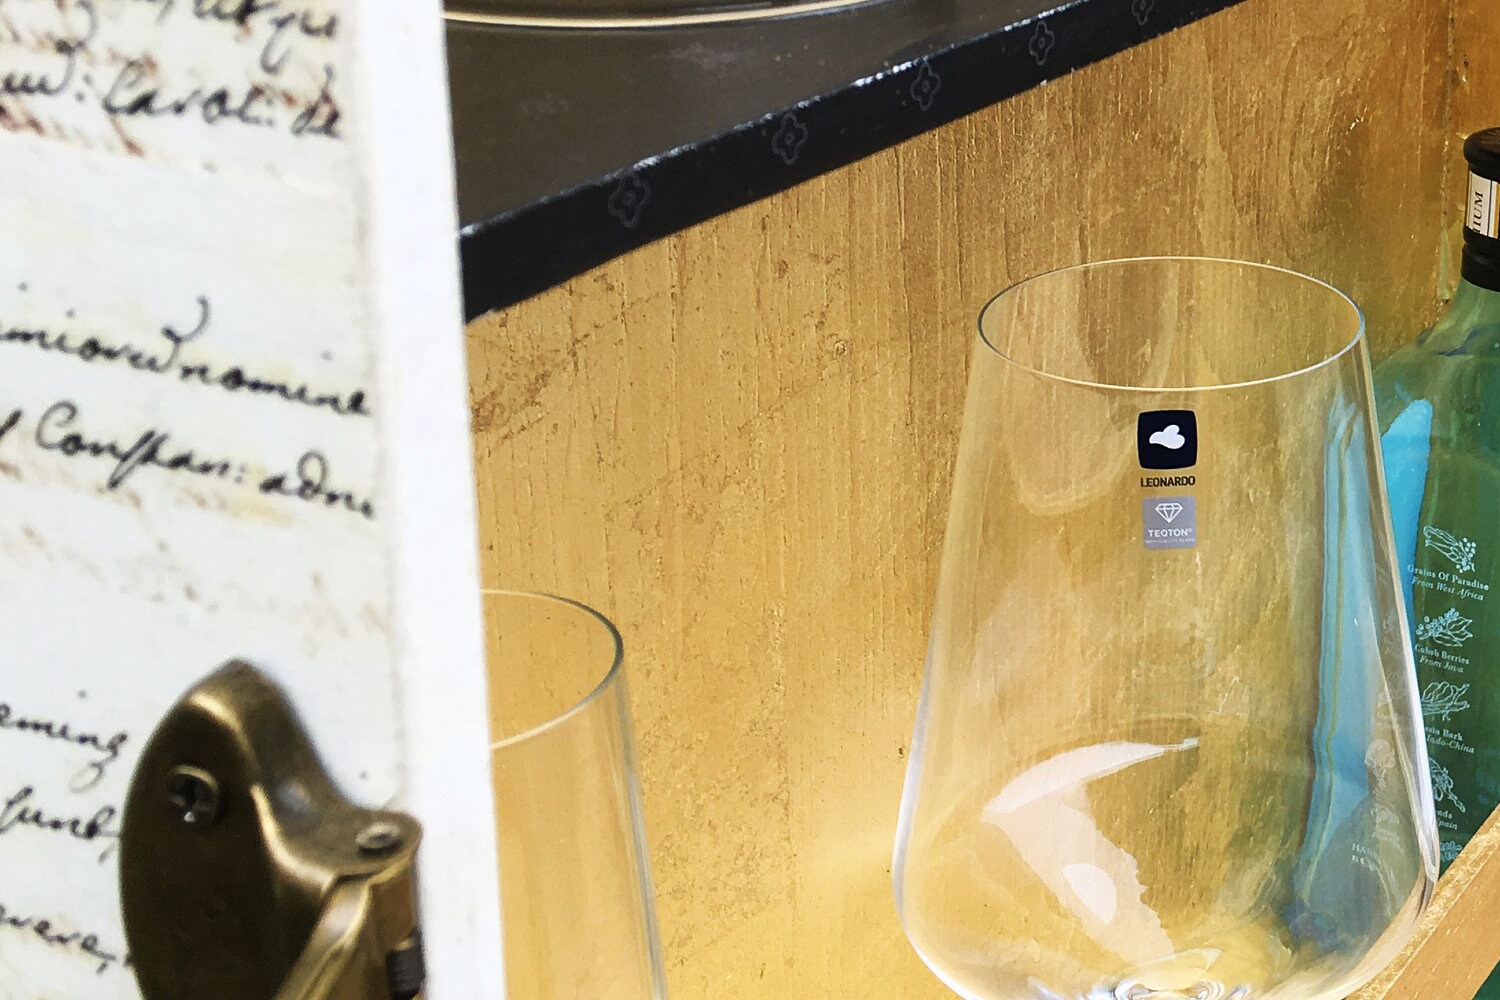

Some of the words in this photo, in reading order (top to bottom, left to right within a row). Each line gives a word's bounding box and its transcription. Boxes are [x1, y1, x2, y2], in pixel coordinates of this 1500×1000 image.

[1140, 475, 1196, 488] LEONARDO
[1407, 564, 1436, 578] Grains
[1438, 571, 1450, 581] Of
[1452, 574, 1490, 591] Paradise
[1411, 576, 1434, 589] From
[1436, 582, 1455, 594] West
[1456, 588, 1485, 601] Africa
[1419, 655, 1442, 668] From
[1443, 662, 1464, 673] Java
[1441, 650, 1470, 665] Berries
[1442, 728, 1463, 741] Bark
[1438, 820, 1458, 830] pain
